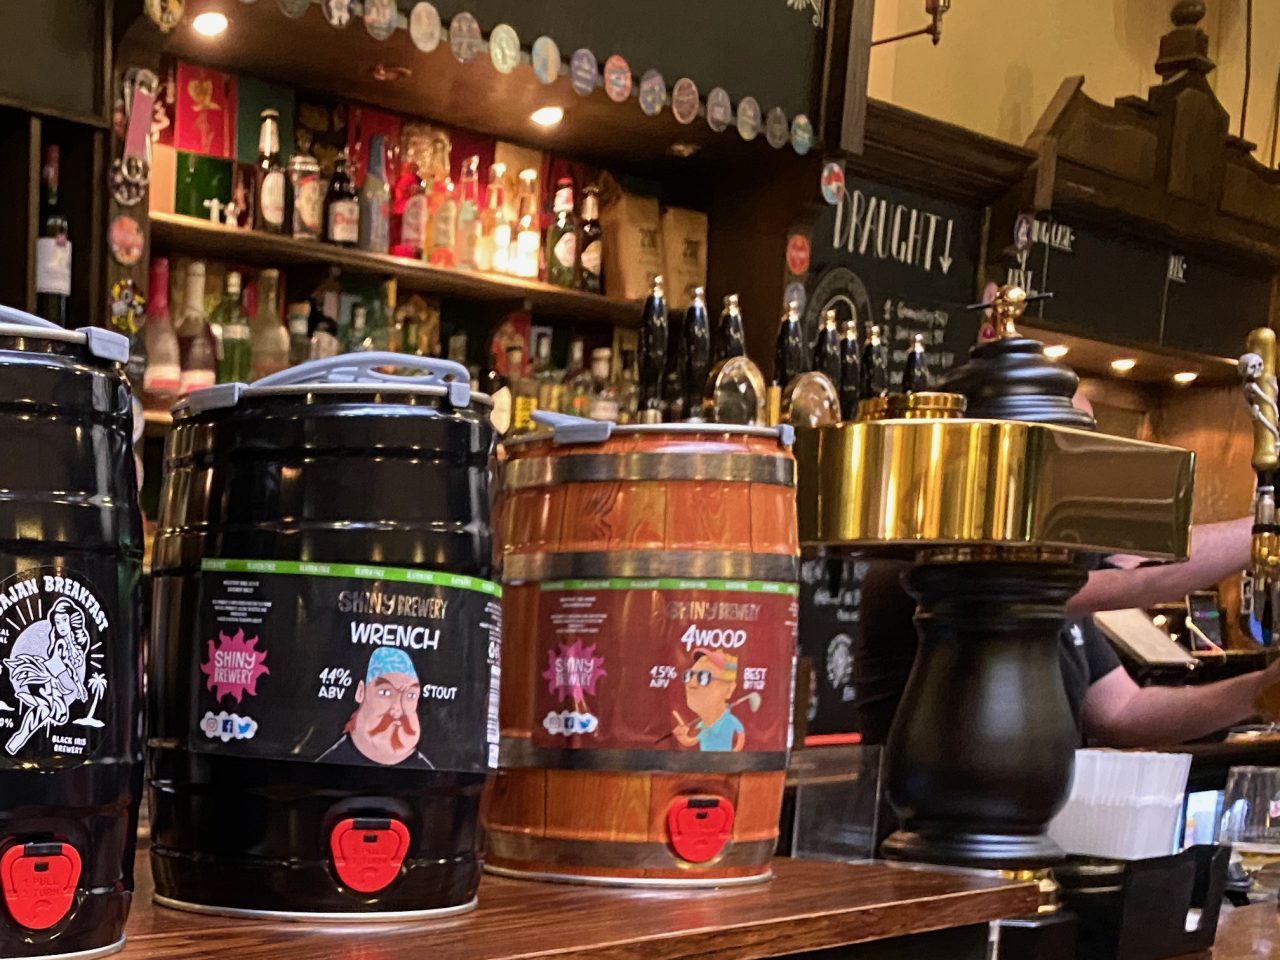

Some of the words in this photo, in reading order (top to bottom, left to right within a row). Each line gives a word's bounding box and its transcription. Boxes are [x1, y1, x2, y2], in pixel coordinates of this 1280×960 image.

[832, 187, 943, 272] DRAUGHT
[42, 575, 109, 632] BREAKFAST
[338, 590, 396, 615] SHINY
[396, 594, 448, 619] BREWERY
[350, 620, 440, 650] WRENCH
[214, 650, 257, 670] SHINY
[214, 667, 254, 685] BREWERY
[319, 667, 352, 687] 4.4%
[743, 667, 768, 681] BEST
[318, 685, 346, 700] ABV
[422, 684, 458, 700] STOUT
[51, 735, 73, 745] BLACK
